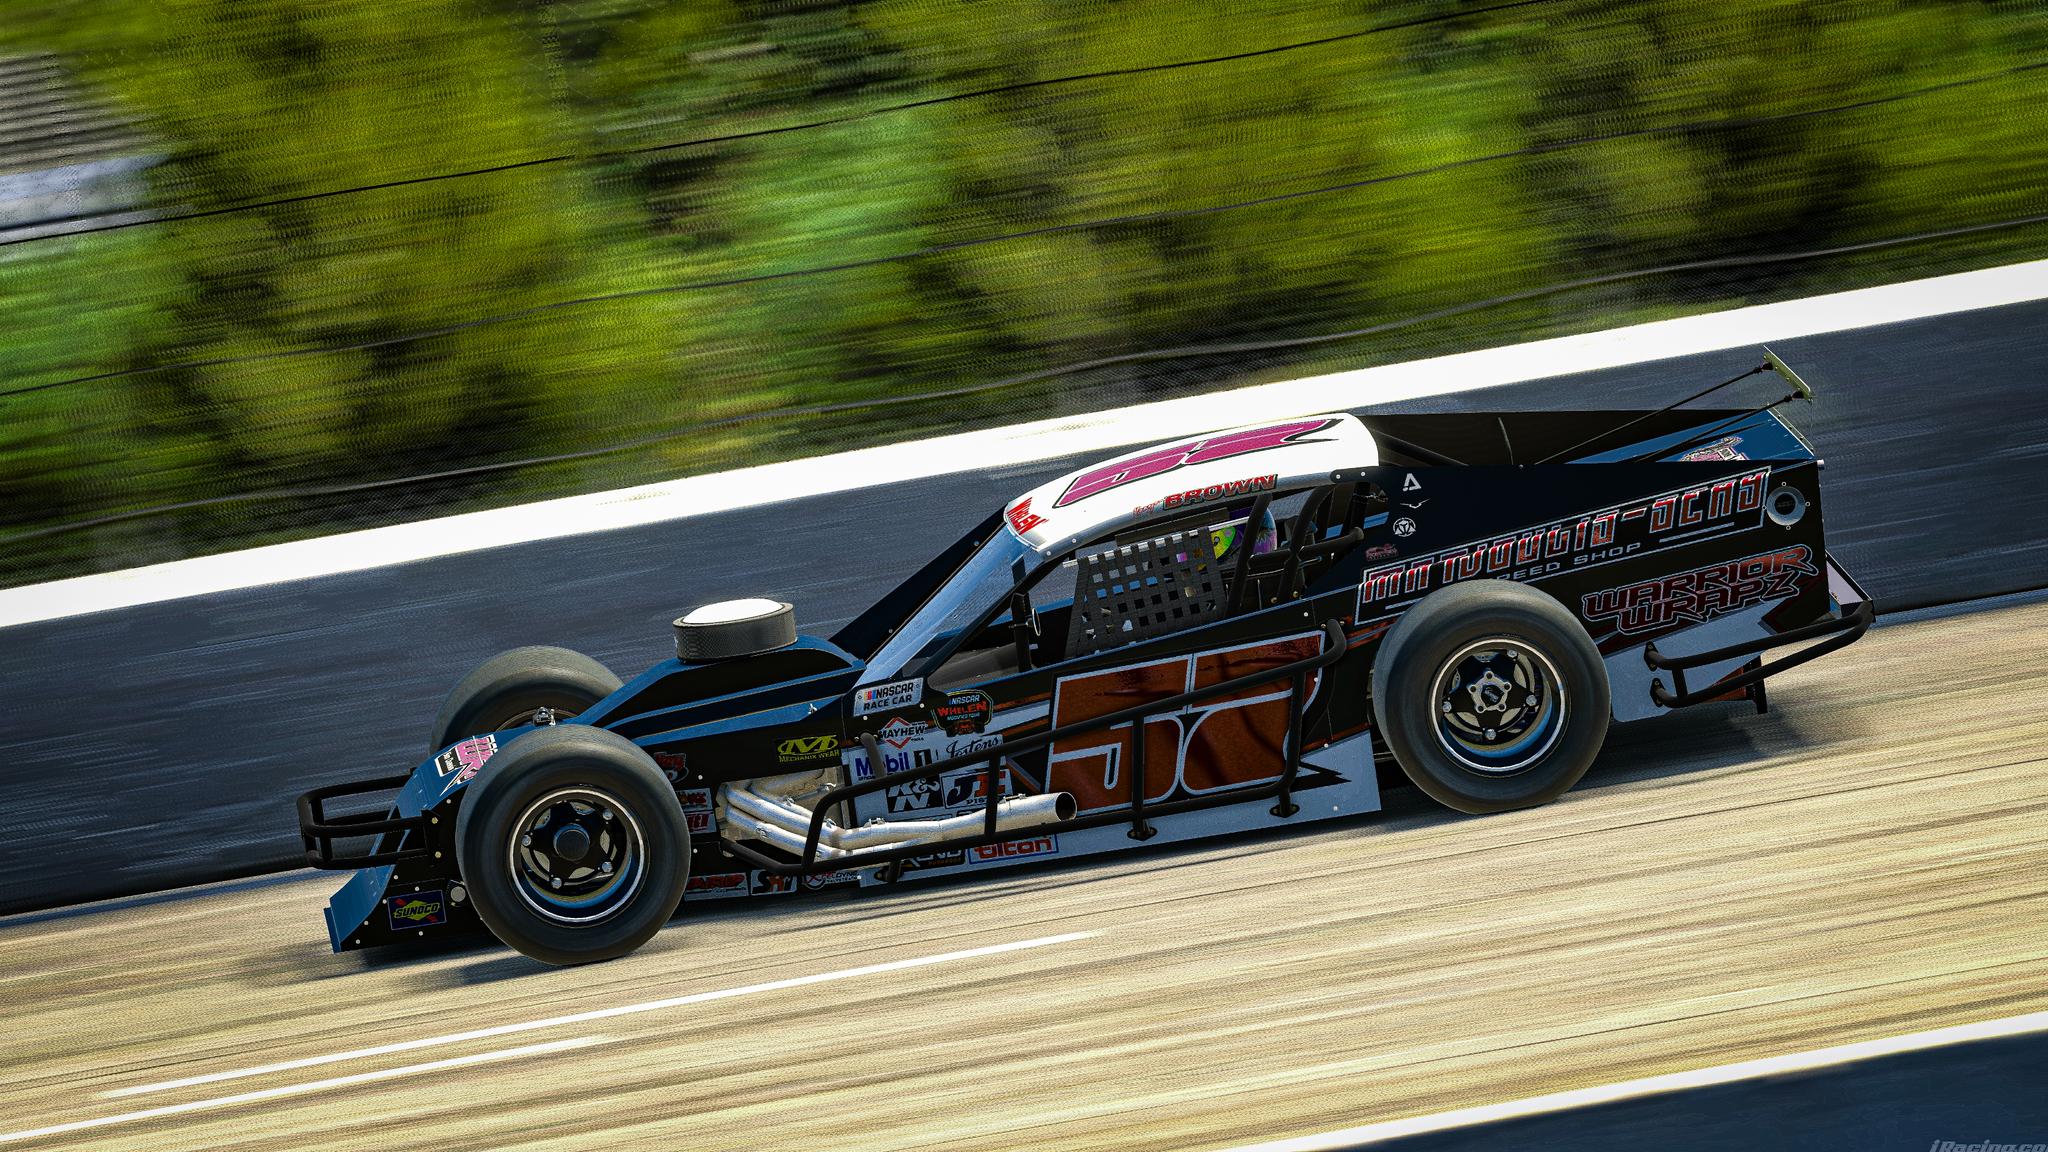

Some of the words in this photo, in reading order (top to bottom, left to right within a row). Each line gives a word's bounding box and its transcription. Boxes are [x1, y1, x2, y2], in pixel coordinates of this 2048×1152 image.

[1163, 474, 1278, 510] BROWN
[1497, 562, 1561, 580] PEED
[1573, 542, 1641, 566] SHOP
[1583, 546, 1817, 619] WARRIOR
[1618, 573, 1799, 634] WRAPZ
[875, 682, 914, 700] NASCAR
[950, 694, 981, 705] NASCAR
[863, 698, 890, 711] RACE
[892, 694, 913, 705] CAR
[936, 700, 987, 717] WHELEN
[878, 725, 926, 739] MAYHEW
[779, 752, 817, 763] MECHANIX
[818, 749, 840, 759] WEAR
[855, 752, 910, 777] Mbil
[393, 902, 440, 919] SUNOCO
